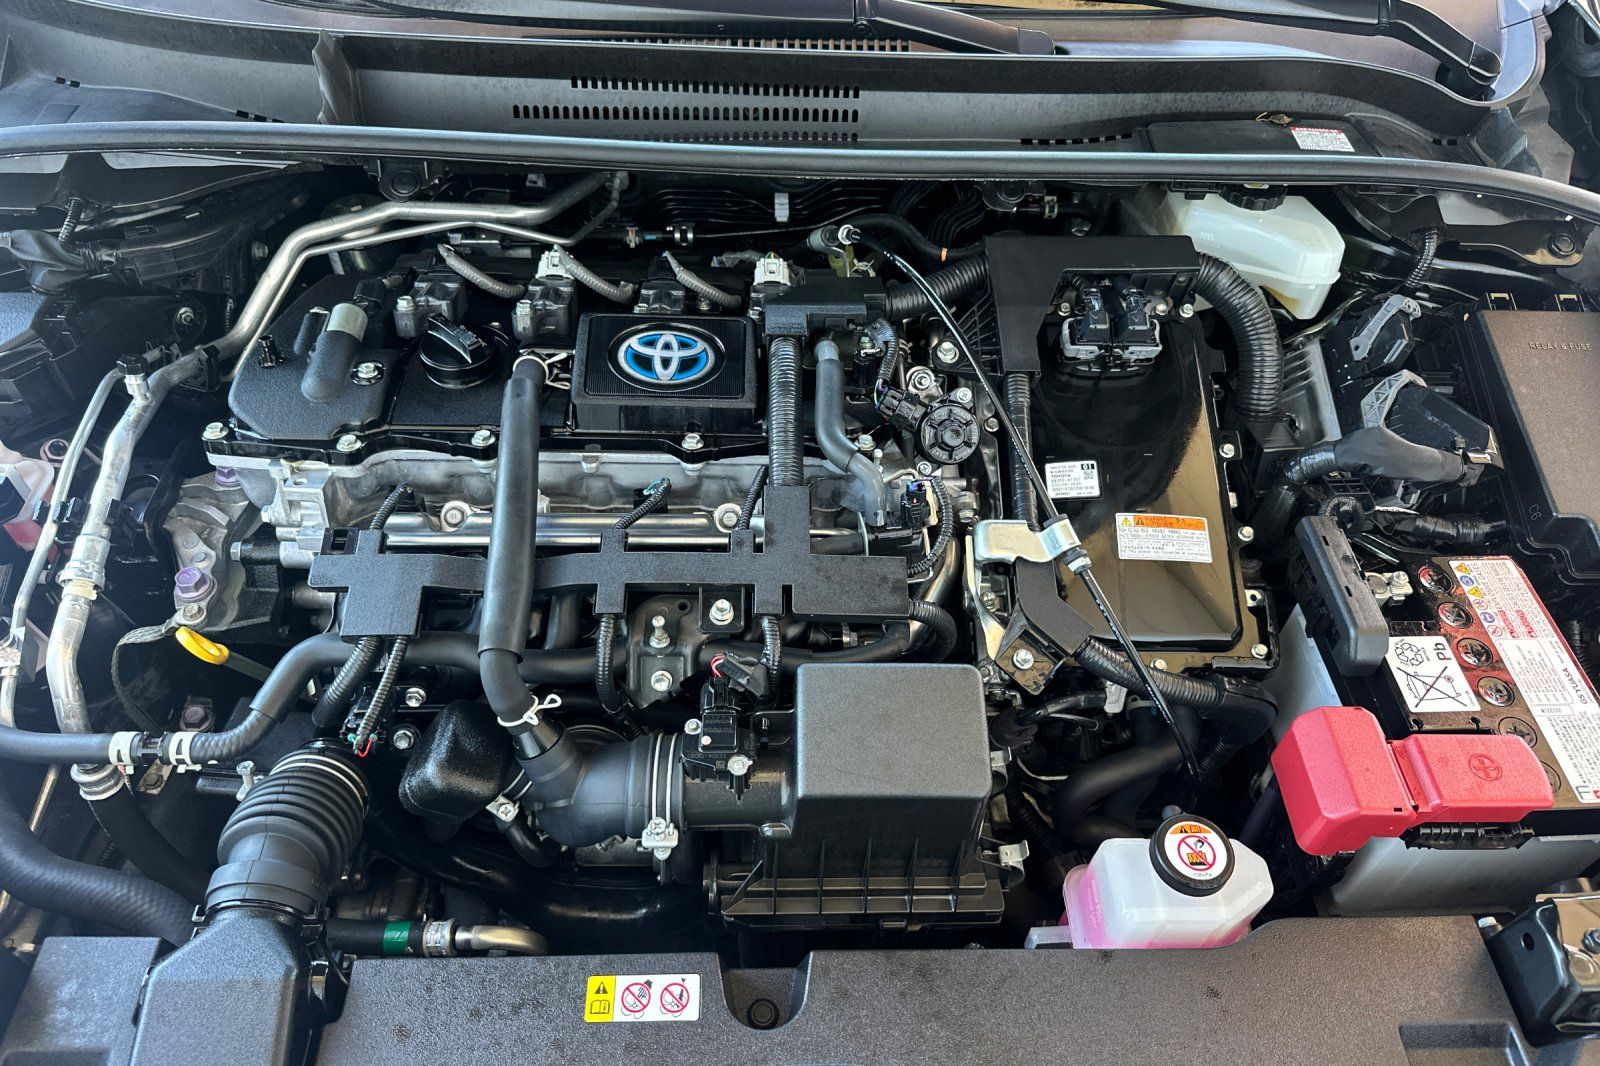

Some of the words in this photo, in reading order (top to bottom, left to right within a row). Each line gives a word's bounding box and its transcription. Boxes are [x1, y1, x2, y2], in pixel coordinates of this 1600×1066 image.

[1528, 341, 1558, 350] RELAY
[1560, 342, 1568, 350] &
[1569, 342, 1593, 351] FUSE
[1433, 642, 1452, 661] Pb
[1562, 667, 1579, 693] YUASA
